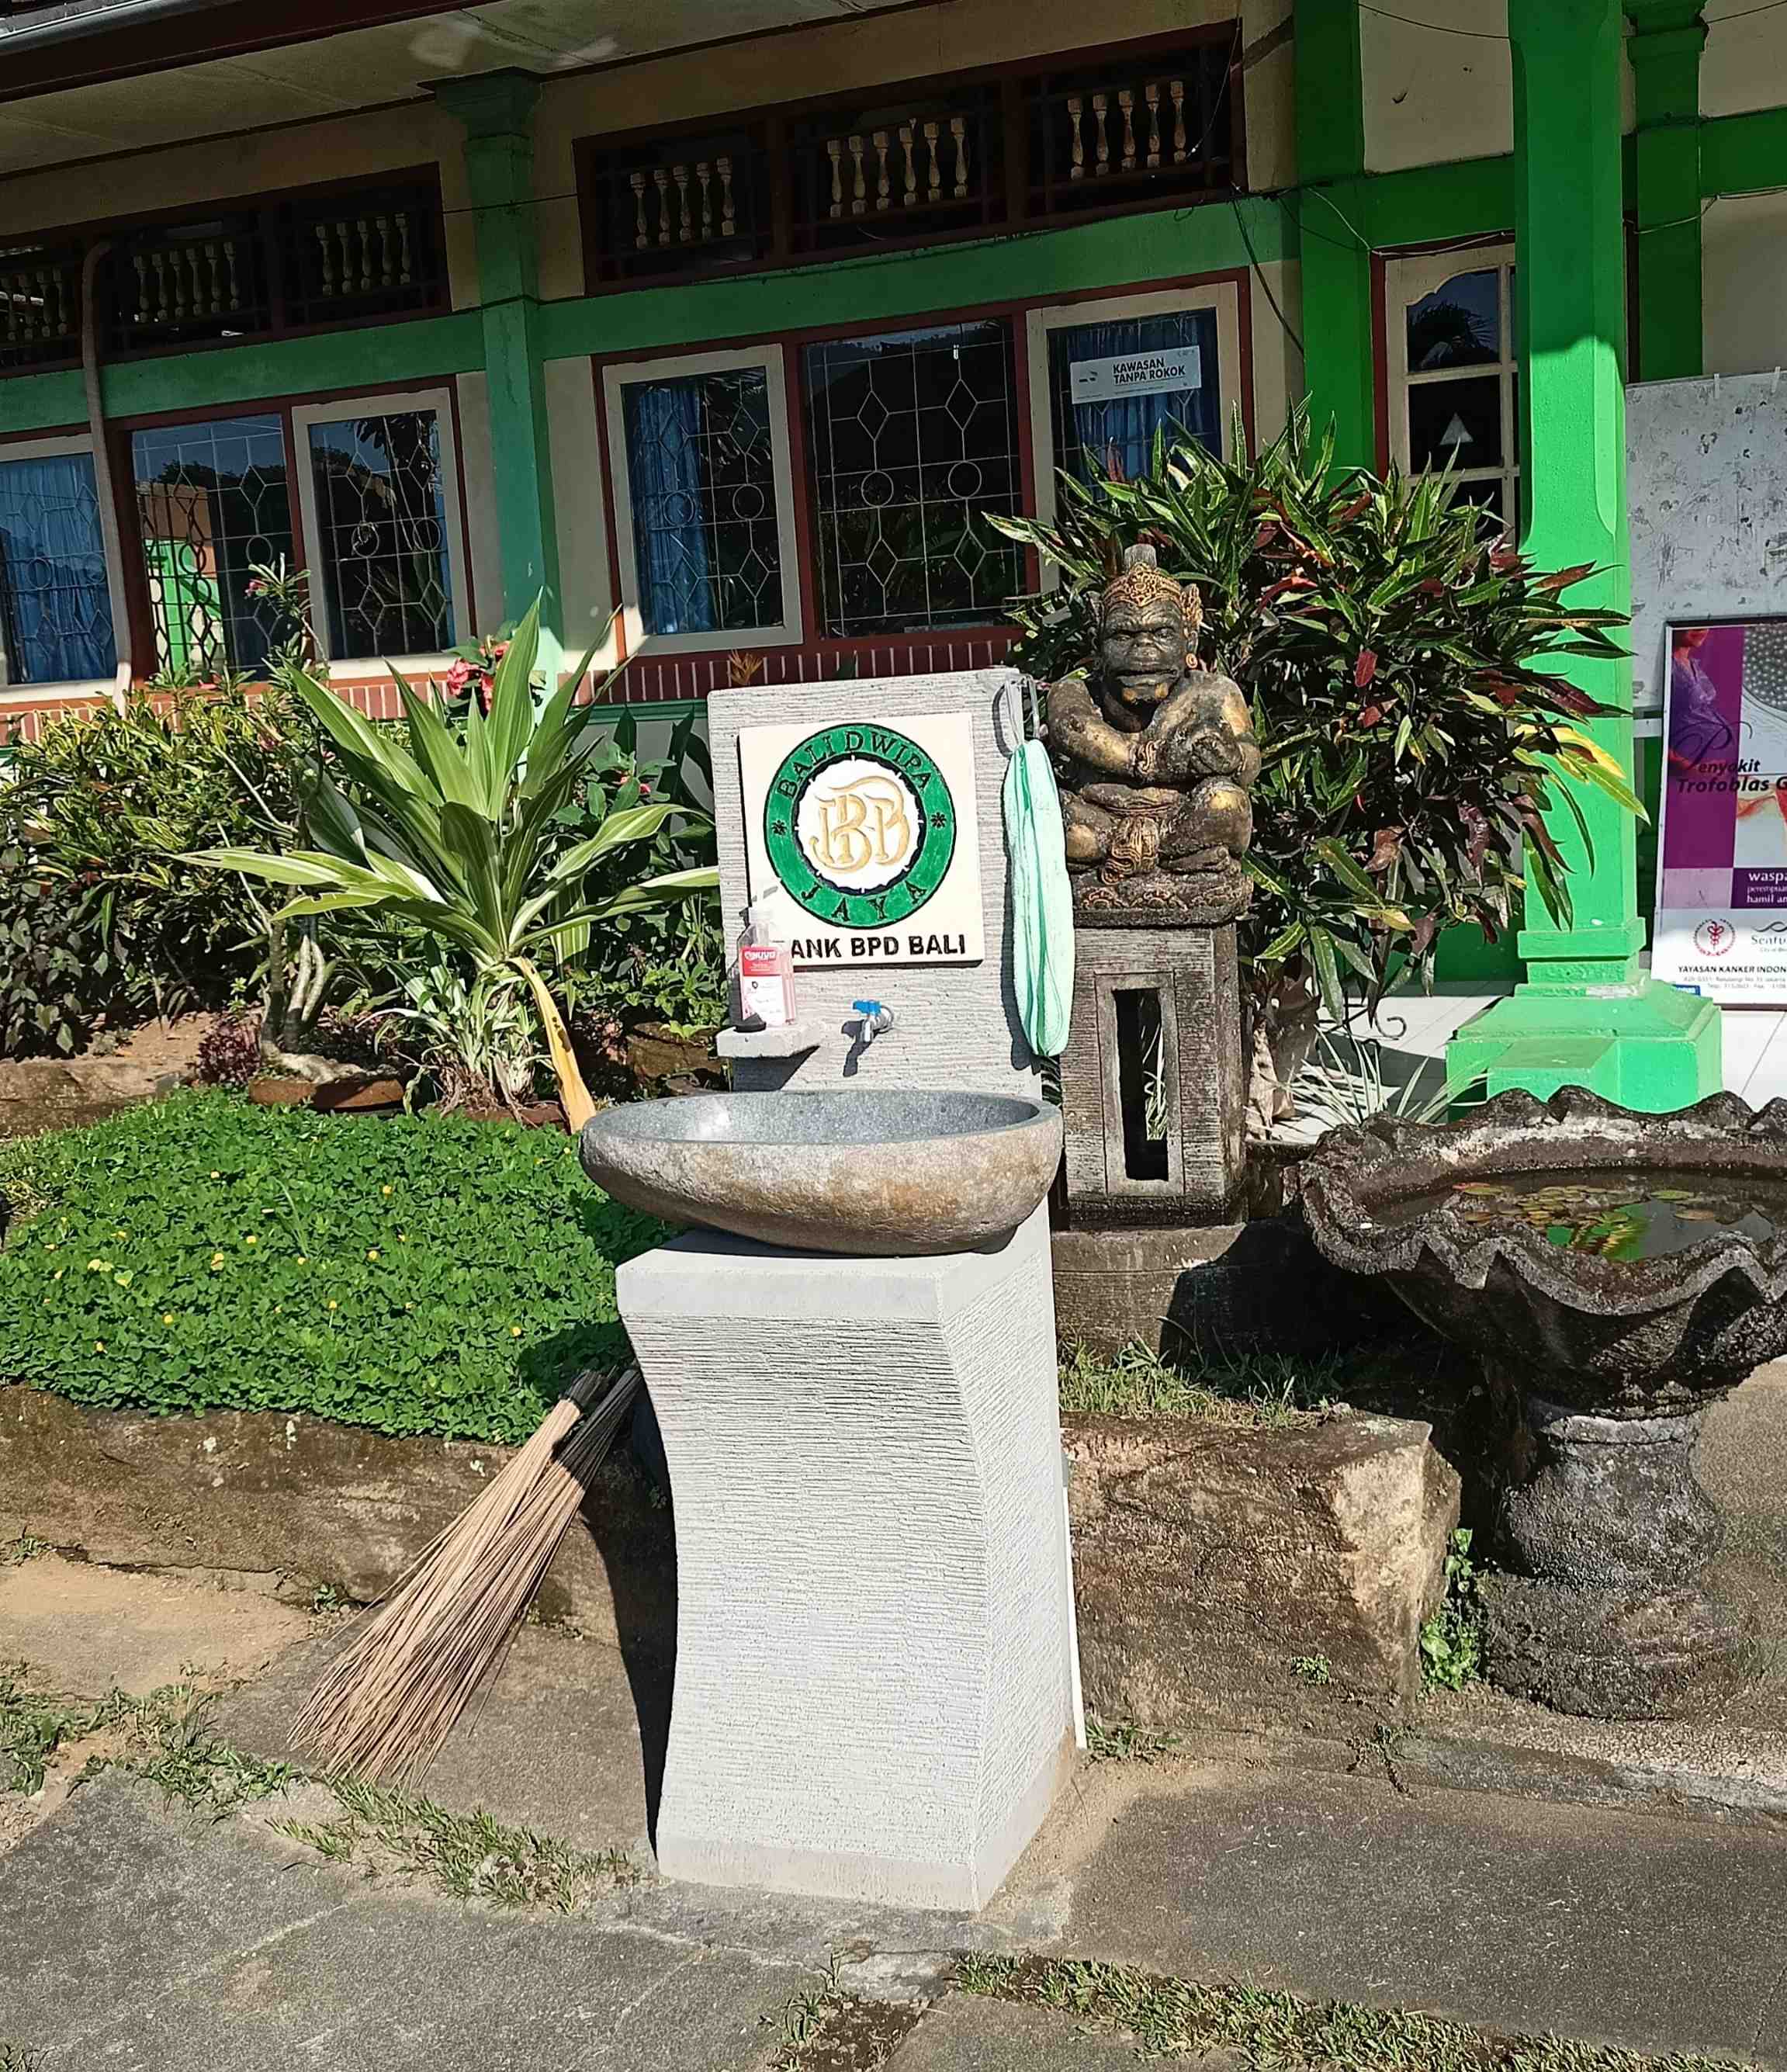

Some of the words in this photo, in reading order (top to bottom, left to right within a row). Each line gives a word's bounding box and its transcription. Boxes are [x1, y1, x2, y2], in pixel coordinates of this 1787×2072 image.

[1113, 358, 1165, 374] KAWASAN
[1113, 372, 1147, 384] TANPA
[1149, 365, 1186, 379] ROKOK
[777, 735, 836, 800] BALI
[844, 729, 933, 791] DWIPA
[1678, 775, 1770, 793] Trofoblas
[801, 881, 928, 922] JAYA
[1747, 894, 1775, 903] hamil
[791, 937, 842, 959] ANK
[850, 936, 899, 957] BPD
[908, 934, 966, 955] BALI
